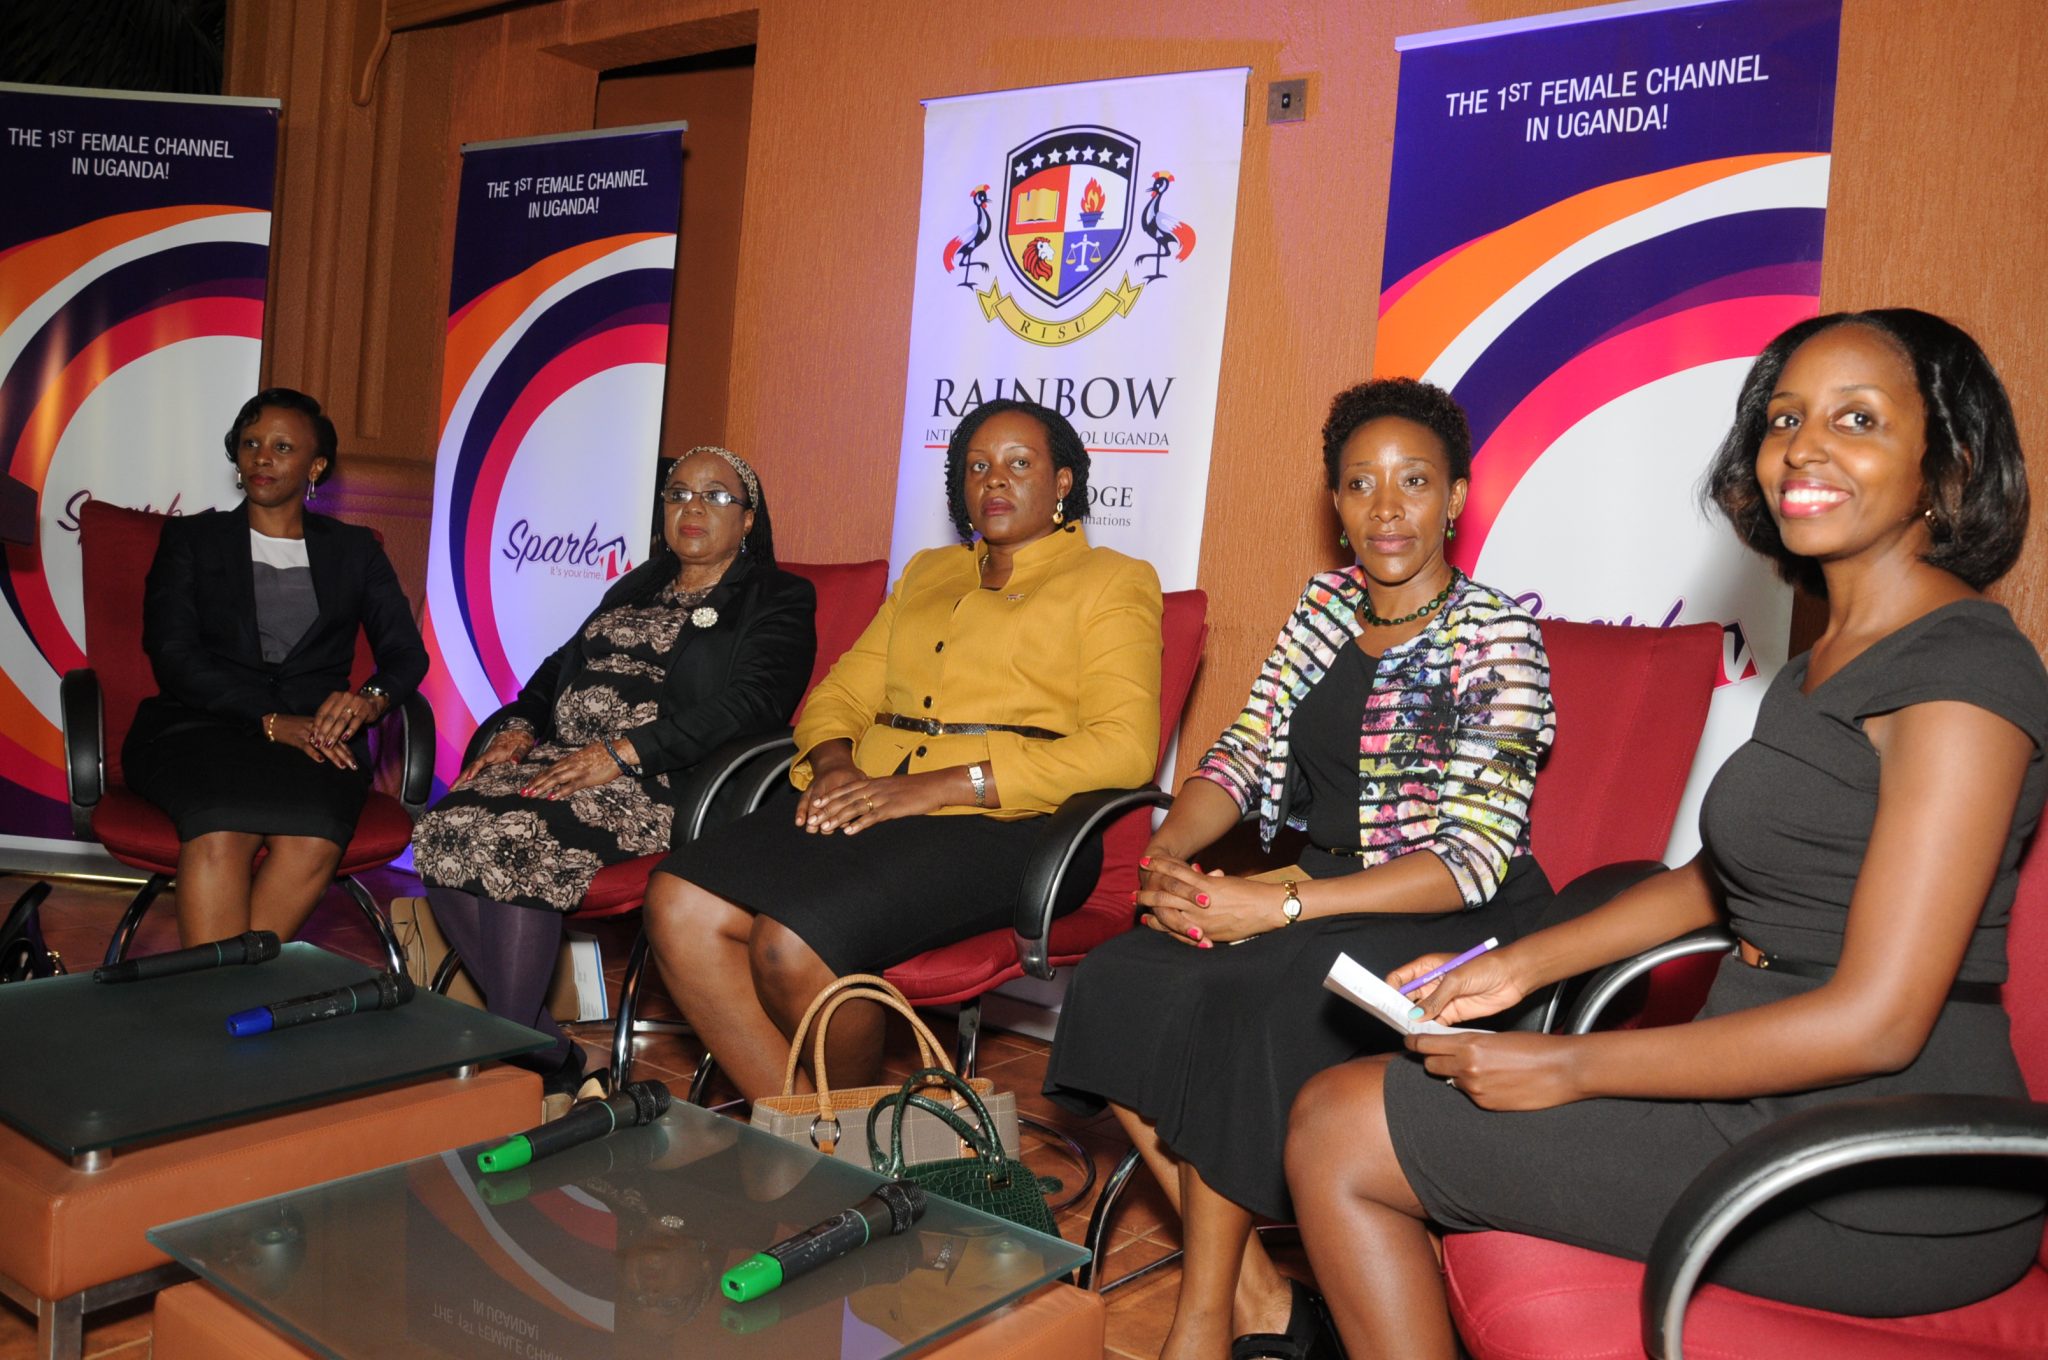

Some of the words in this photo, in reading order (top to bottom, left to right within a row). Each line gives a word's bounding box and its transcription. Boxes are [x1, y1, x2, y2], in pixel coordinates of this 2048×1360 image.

[1446, 89, 1488, 117] THE
[1497, 82, 1532, 110] 1ST
[1540, 70, 1637, 106] FEMALE
[1646, 54, 1769, 95] CHANNEL
[1525, 116, 1549, 142] IN
[1557, 103, 1669, 139] UGANDA!
[8, 127, 42, 148] THE
[49, 130, 75, 148] 1ST
[81, 133, 149, 155] FEMALE
[154, 137, 234, 159] CHANNEL
[71, 157, 89, 175] IN
[94, 159, 170, 180] UGANDA!
[487, 181, 510, 199] THE
[514, 177, 533, 196] 1ST
[536, 174, 584, 194] FEMALE
[588, 169, 649, 190] CHANNEL
[528, 202, 541, 218] IN
[543, 197, 599, 217] UGANDA!
[1020, 317, 1087, 340] RISU
[1103, 431, 1169, 446] UGANDA
[502, 519, 600, 573] Spark
